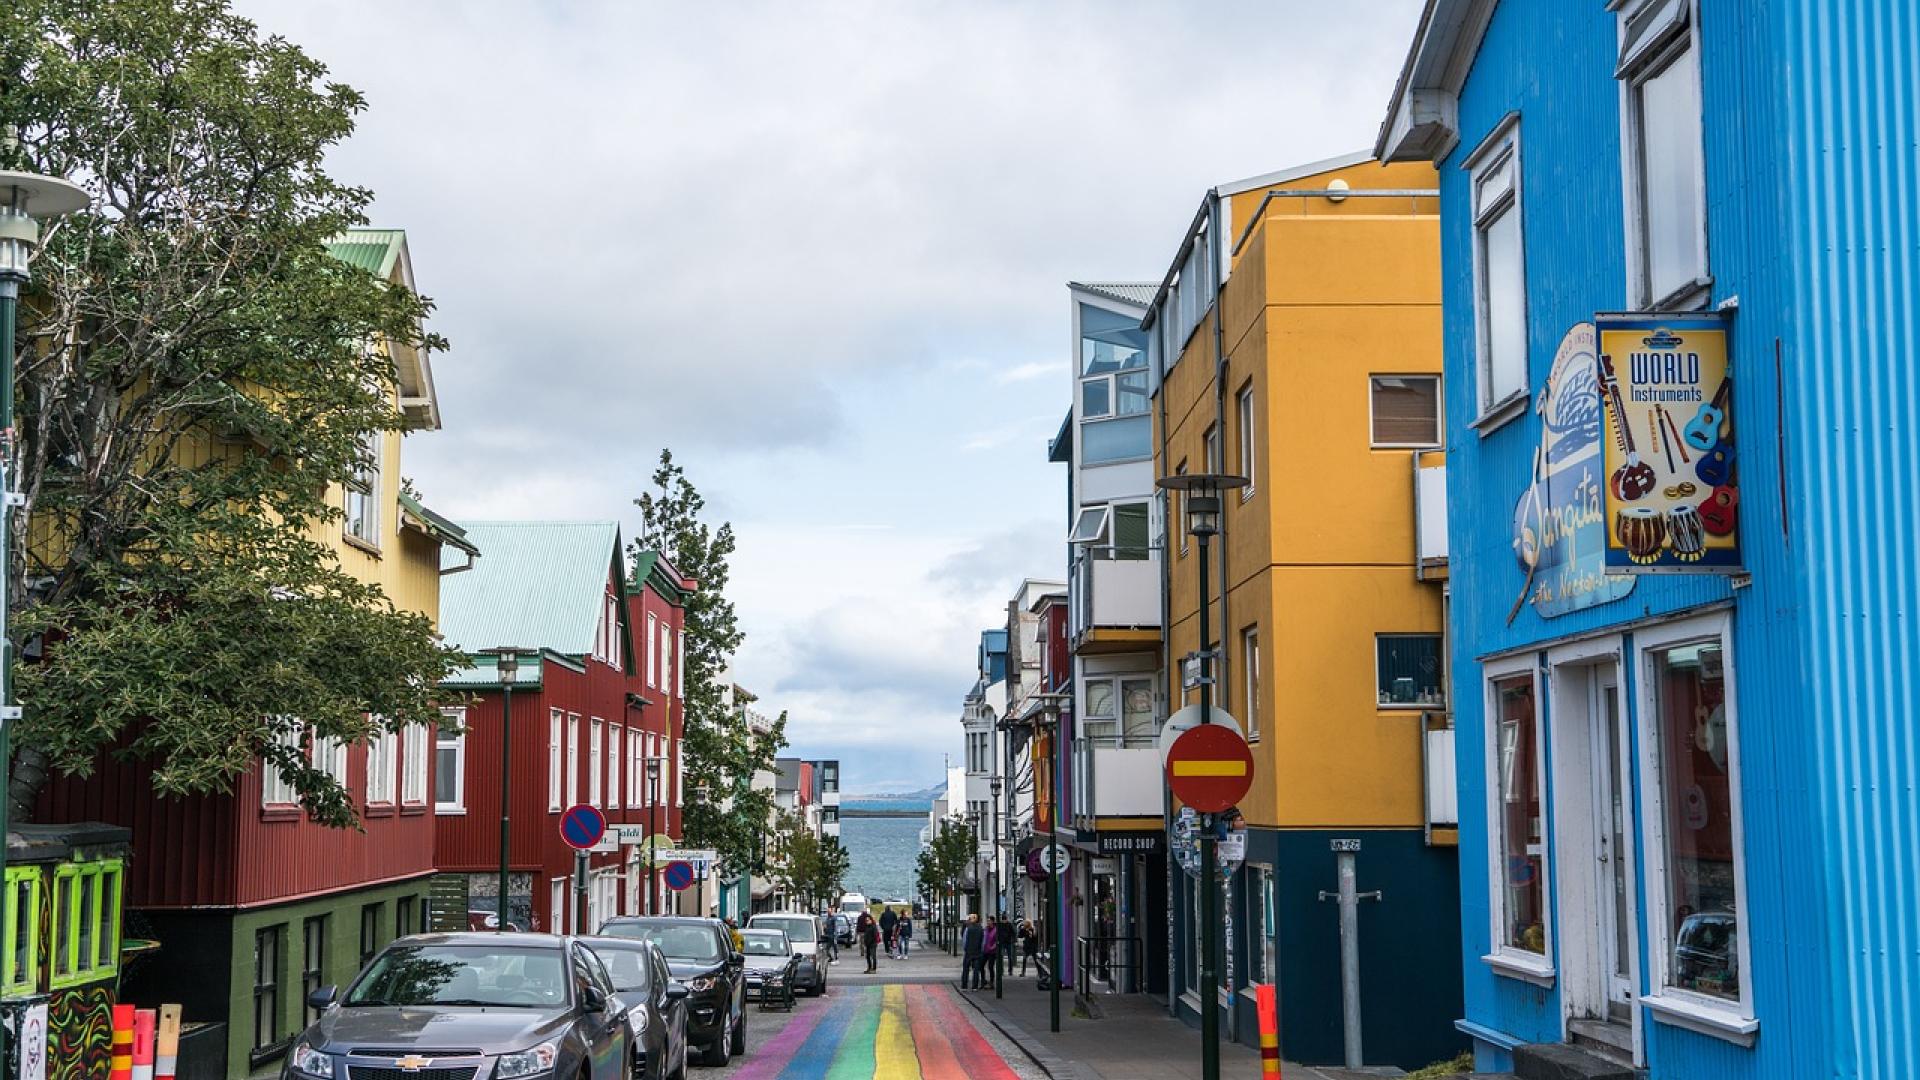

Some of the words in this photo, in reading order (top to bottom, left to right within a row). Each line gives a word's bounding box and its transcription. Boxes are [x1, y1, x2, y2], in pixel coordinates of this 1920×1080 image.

[1630, 352, 1699, 385] WORLD
[1630, 384, 1702, 402] Instruments
[1103, 838, 1132, 849] RECORD
[1134, 838, 1156, 849] SHOP
